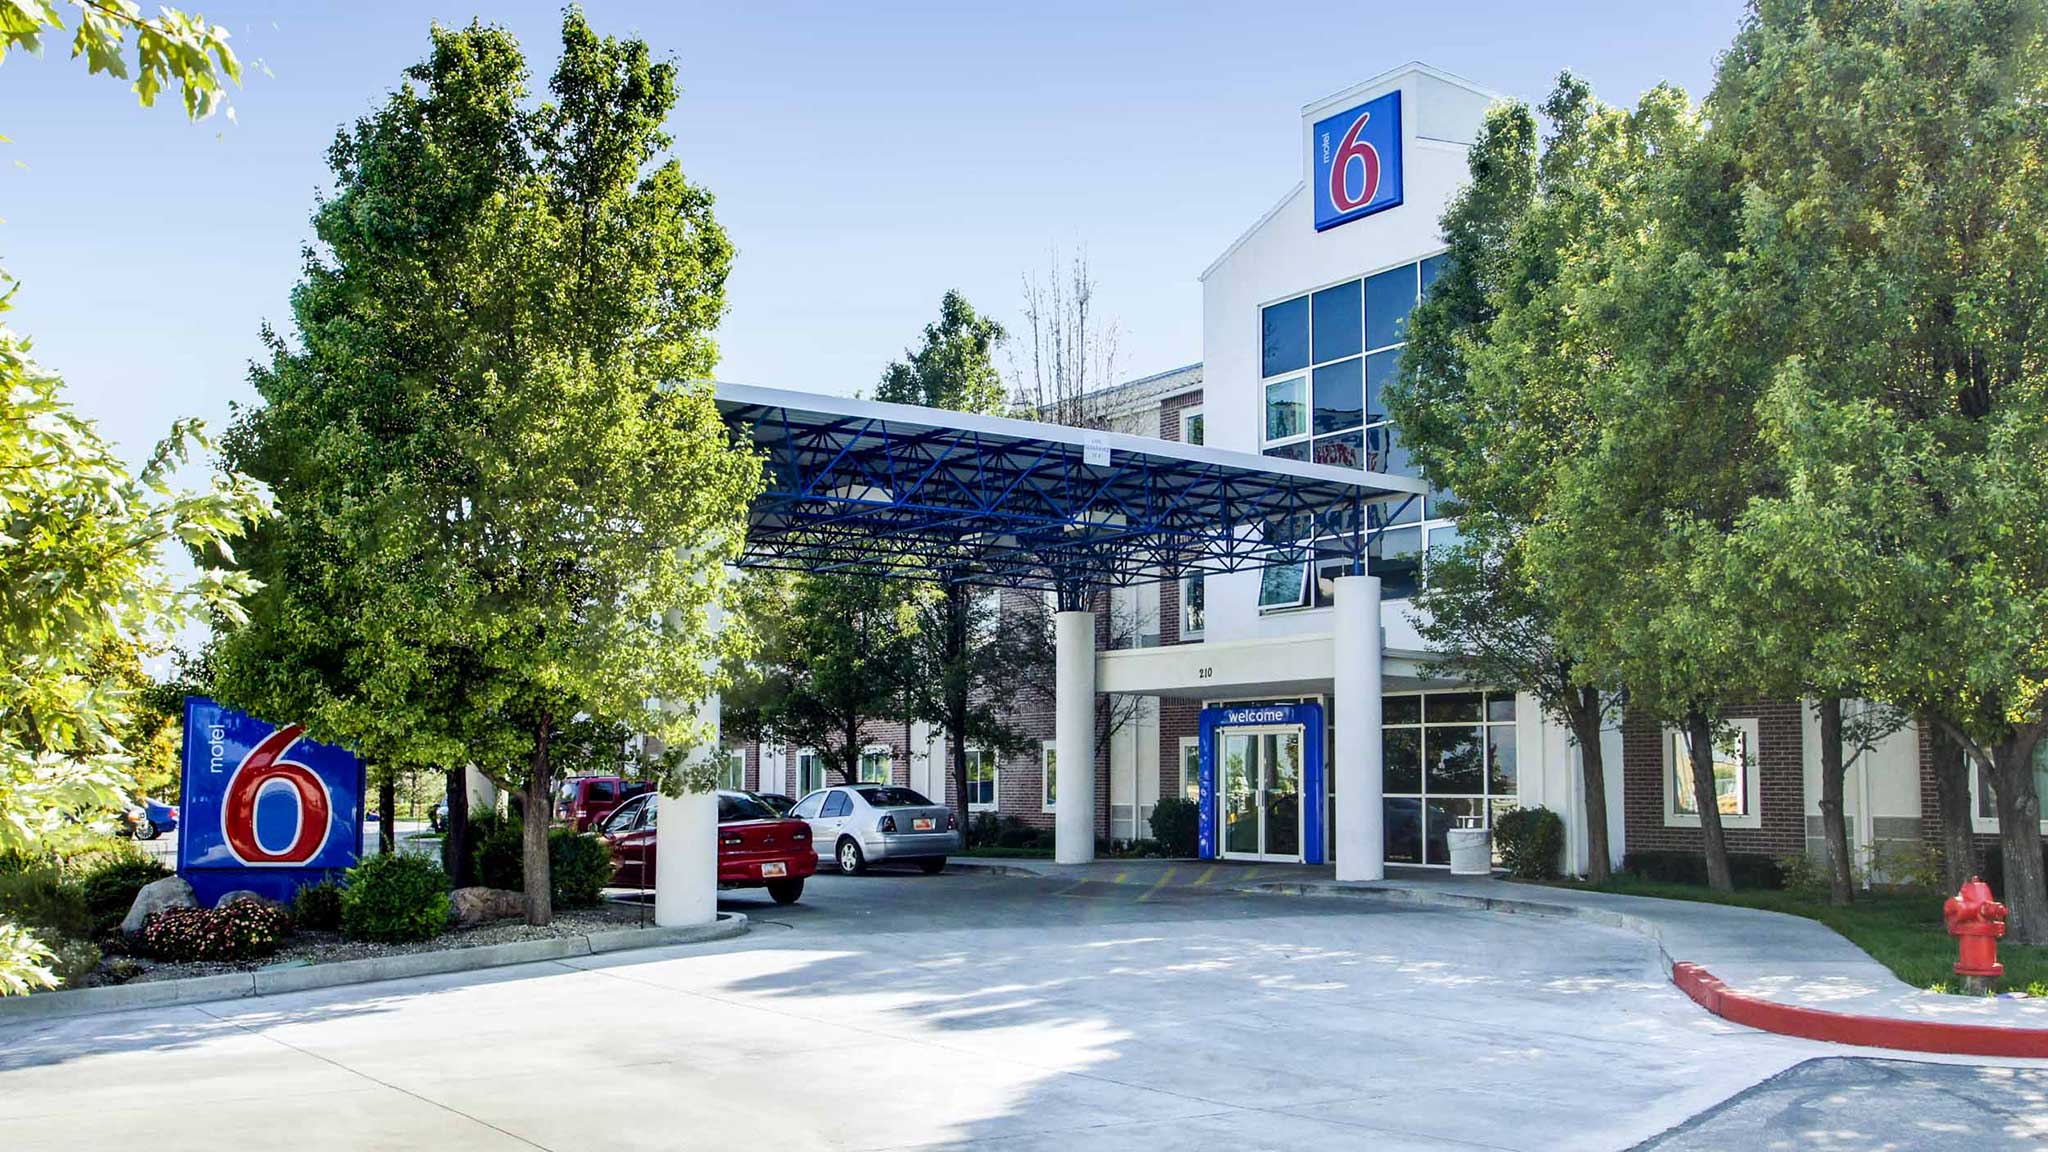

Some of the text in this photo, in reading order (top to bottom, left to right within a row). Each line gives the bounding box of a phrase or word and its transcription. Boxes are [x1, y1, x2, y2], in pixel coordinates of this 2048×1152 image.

[1321, 112, 1381, 214] motel 6
[1199, 667, 1213, 679] 210
[1229, 709, 1284, 723] welcome
[208, 721, 333, 867] motel 6
